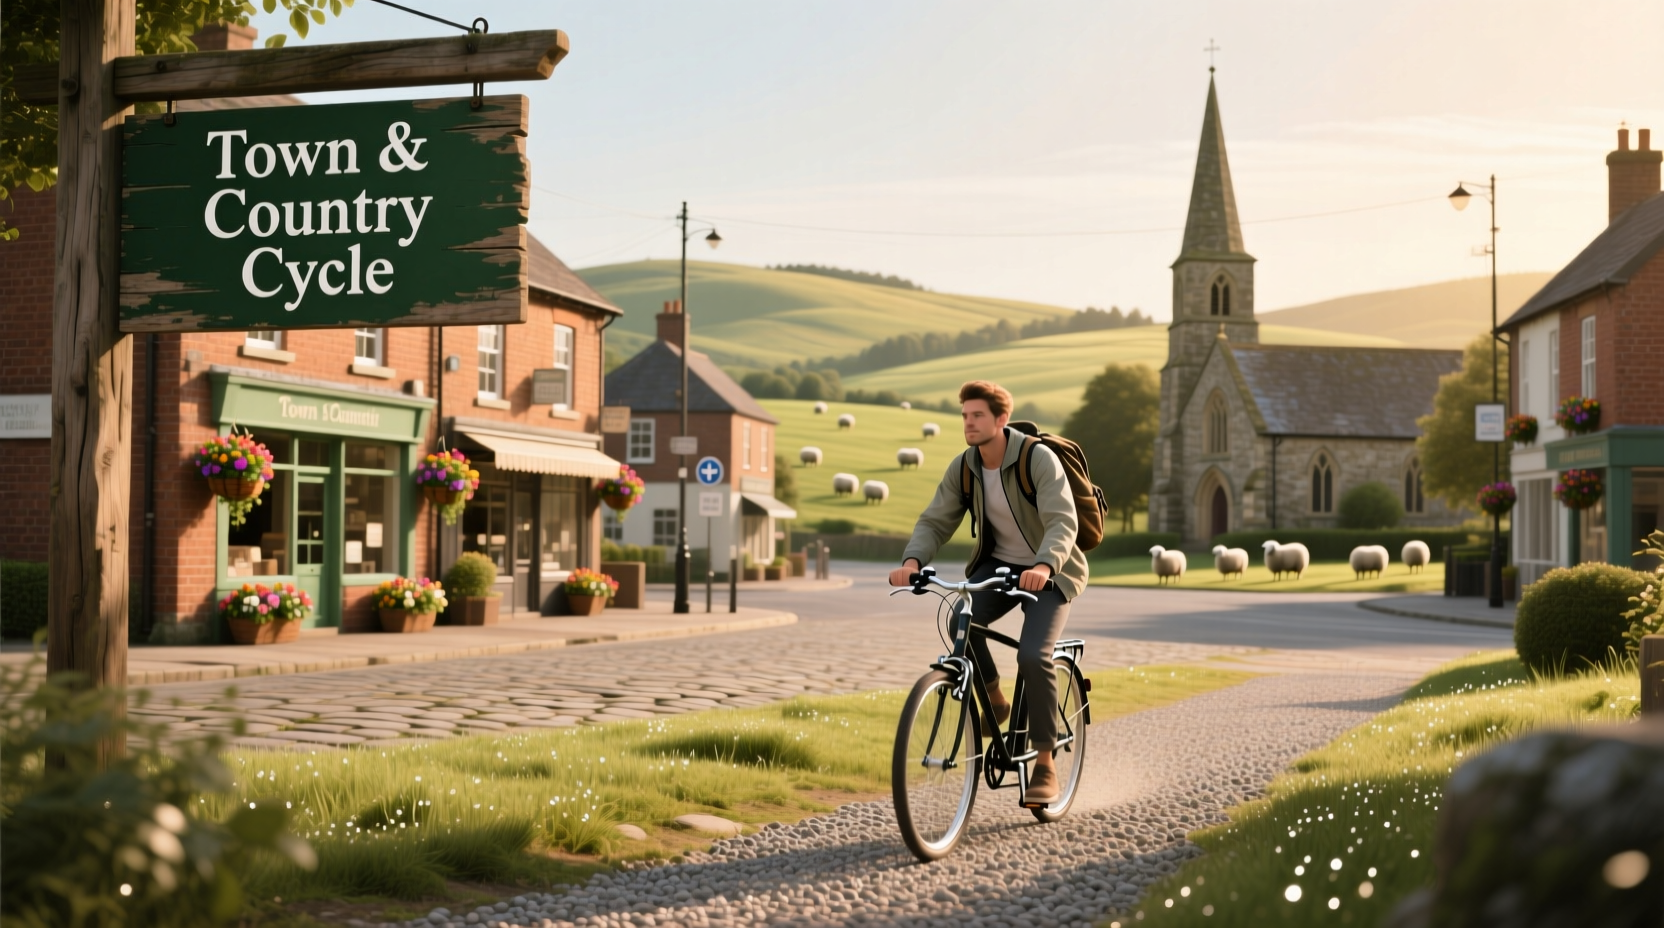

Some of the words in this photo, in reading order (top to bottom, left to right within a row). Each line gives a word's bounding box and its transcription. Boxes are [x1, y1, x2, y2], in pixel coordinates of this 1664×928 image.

[206, 129, 361, 179] Town
[379, 121, 429, 173] &
[204, 189, 433, 248] Country
[242, 243, 394, 312] Cycle
[278, 395, 318, 420] Town
